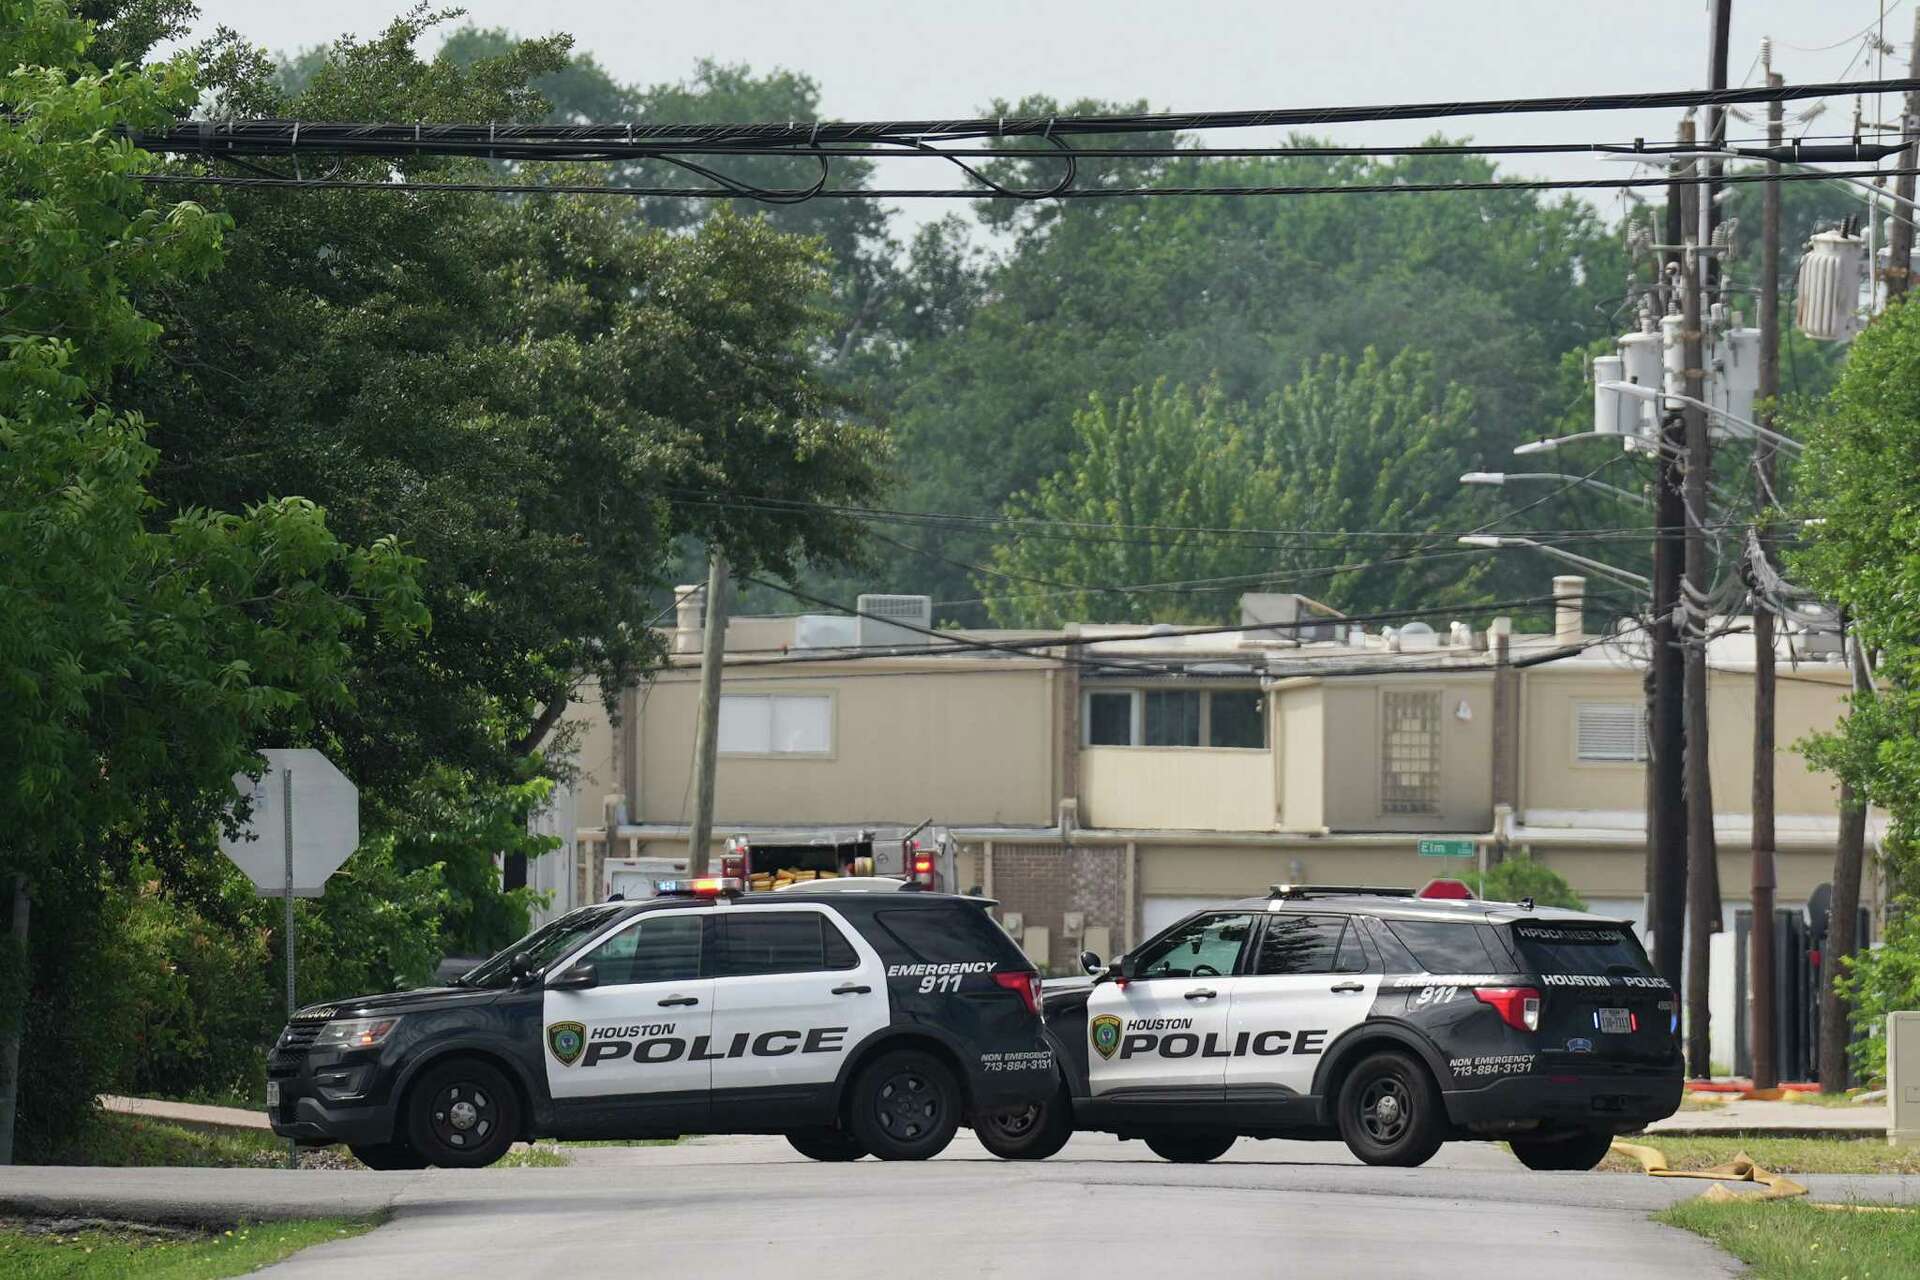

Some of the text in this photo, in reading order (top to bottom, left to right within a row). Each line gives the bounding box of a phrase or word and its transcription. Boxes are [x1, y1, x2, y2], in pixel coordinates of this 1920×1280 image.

[887, 962, 998, 977] EMERGENCY
[918, 974, 963, 993] 911
[1540, 974, 1611, 987] HOUSTON
[1621, 976, 1672, 988] POLICE
[1416, 986, 1459, 1004] 911
[590, 1023, 676, 1039] HOUSTON
[1126, 1018, 1193, 1031] HOUSTON
[580, 1027, 849, 1067] POLICE
[1119, 1030, 1328, 1060] POLICE
[981, 1053, 1002, 1062] NON
[1449, 1054, 1536, 1067] NON EMERGENCY
[984, 1059, 1052, 1072] 713-884-3131
[1452, 1062, 1533, 1077] 713-884-3131
